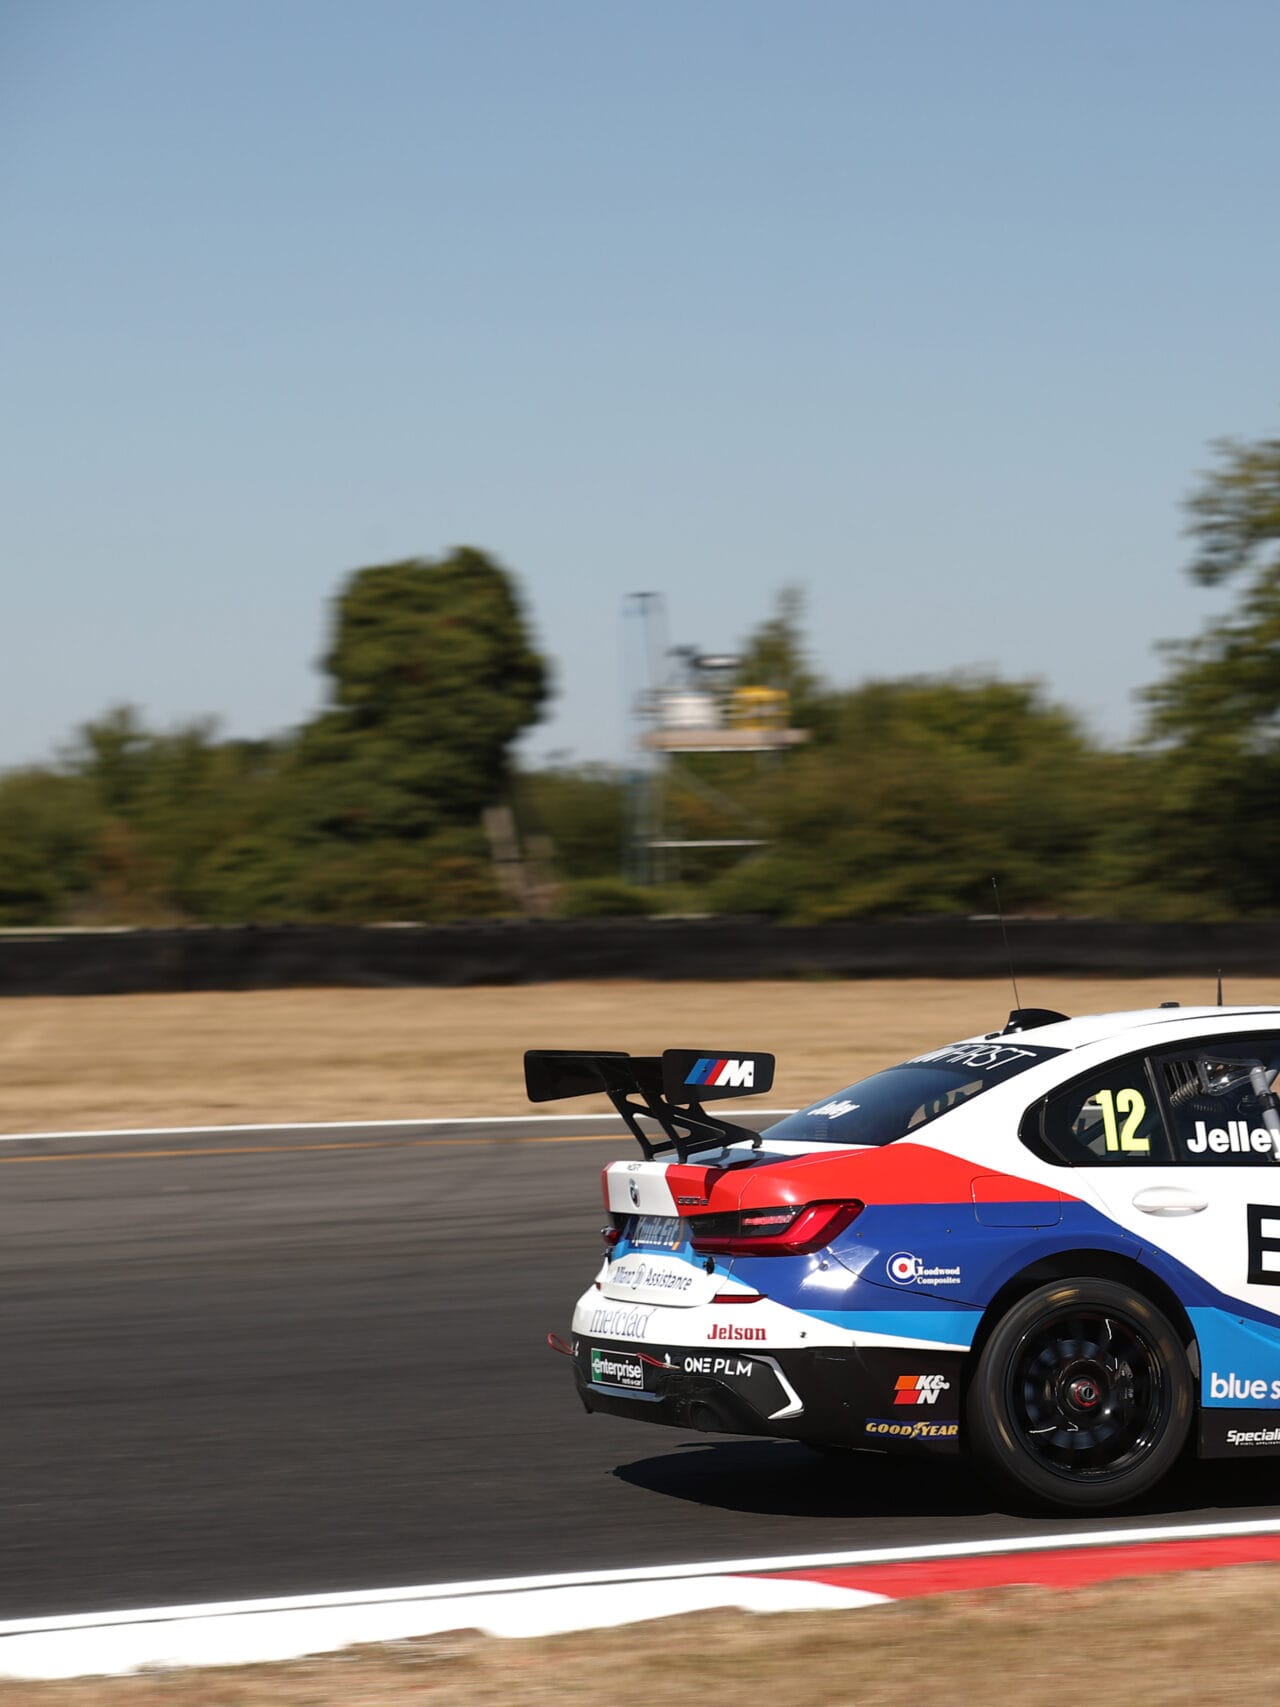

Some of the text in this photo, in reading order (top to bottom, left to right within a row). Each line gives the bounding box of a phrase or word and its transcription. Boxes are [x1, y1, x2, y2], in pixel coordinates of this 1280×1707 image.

[1096, 1088, 1150, 1152] 12
[912, 1258, 961, 1276] Goodwood
[645, 1267, 693, 1291] Assistance
[917, 1276, 961, 1286] Composites
[707, 1324, 767, 1341] Jelson
[592, 1357, 642, 1382] enterprise
[684, 1356, 753, 1377] ONE PLM
[1210, 1372, 1268, 1400] blue
[865, 1421, 959, 1438] GOODYEAR
